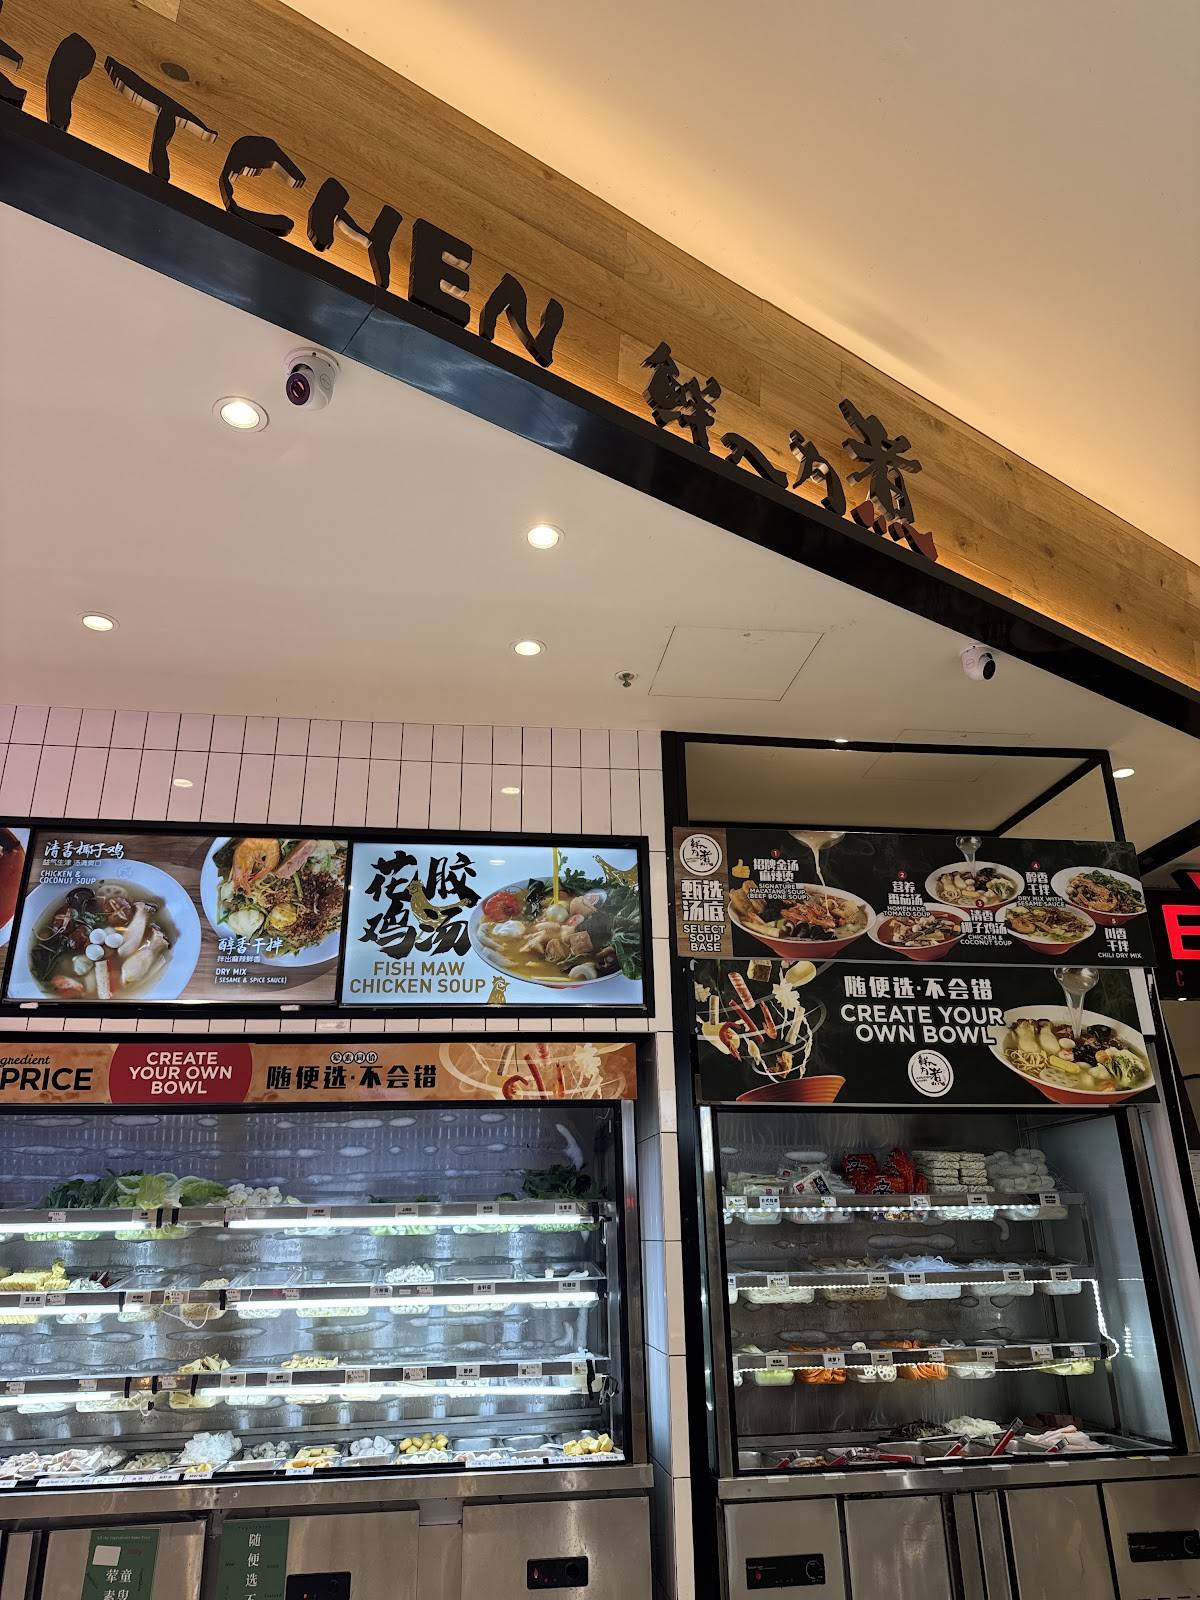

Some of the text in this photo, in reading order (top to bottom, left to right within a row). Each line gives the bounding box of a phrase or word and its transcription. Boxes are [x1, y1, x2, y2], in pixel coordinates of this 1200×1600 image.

[44, 840, 125, 858] 清香椰子鸡
[753, 858, 799, 871] 招牌金汤
[75, 870, 80, 878] &
[365, 850, 482, 908] 花胶
[759, 870, 795, 882] 麻辣烫
[681, 880, 724, 900] 甄选
[682, 900, 725, 922] 汤底
[970, 909, 994, 921] 清香
[358, 902, 472, 960] 鸡汤
[683, 924, 726, 934] SELECT
[689, 933, 721, 943] SOUP
[218, 936, 284, 956] 醇香干拌
[690, 942, 721, 952] BASE
[215, 968, 247, 976] DRY MIX
[373, 961, 466, 976] FISH MAW
[250, 976, 266, 984] SPICE
[267, 976, 287, 984] SAUCE)
[350, 978, 487, 994] CHICKEN SOUP
[844, 975, 994, 1001] 随便选·不会错
[840, 1004, 1006, 1026] CREATE YOUR
[855, 1024, 997, 1045] OWN BOWL
[146, 1051, 218, 1065] CREATE
[0, 1067, 94, 1090] PRICE
[129, 1065, 233, 1080] YOUR OWN
[265, 1065, 437, 1090] 随便选·不会错
[151, 1080, 208, 1095] BOWL
